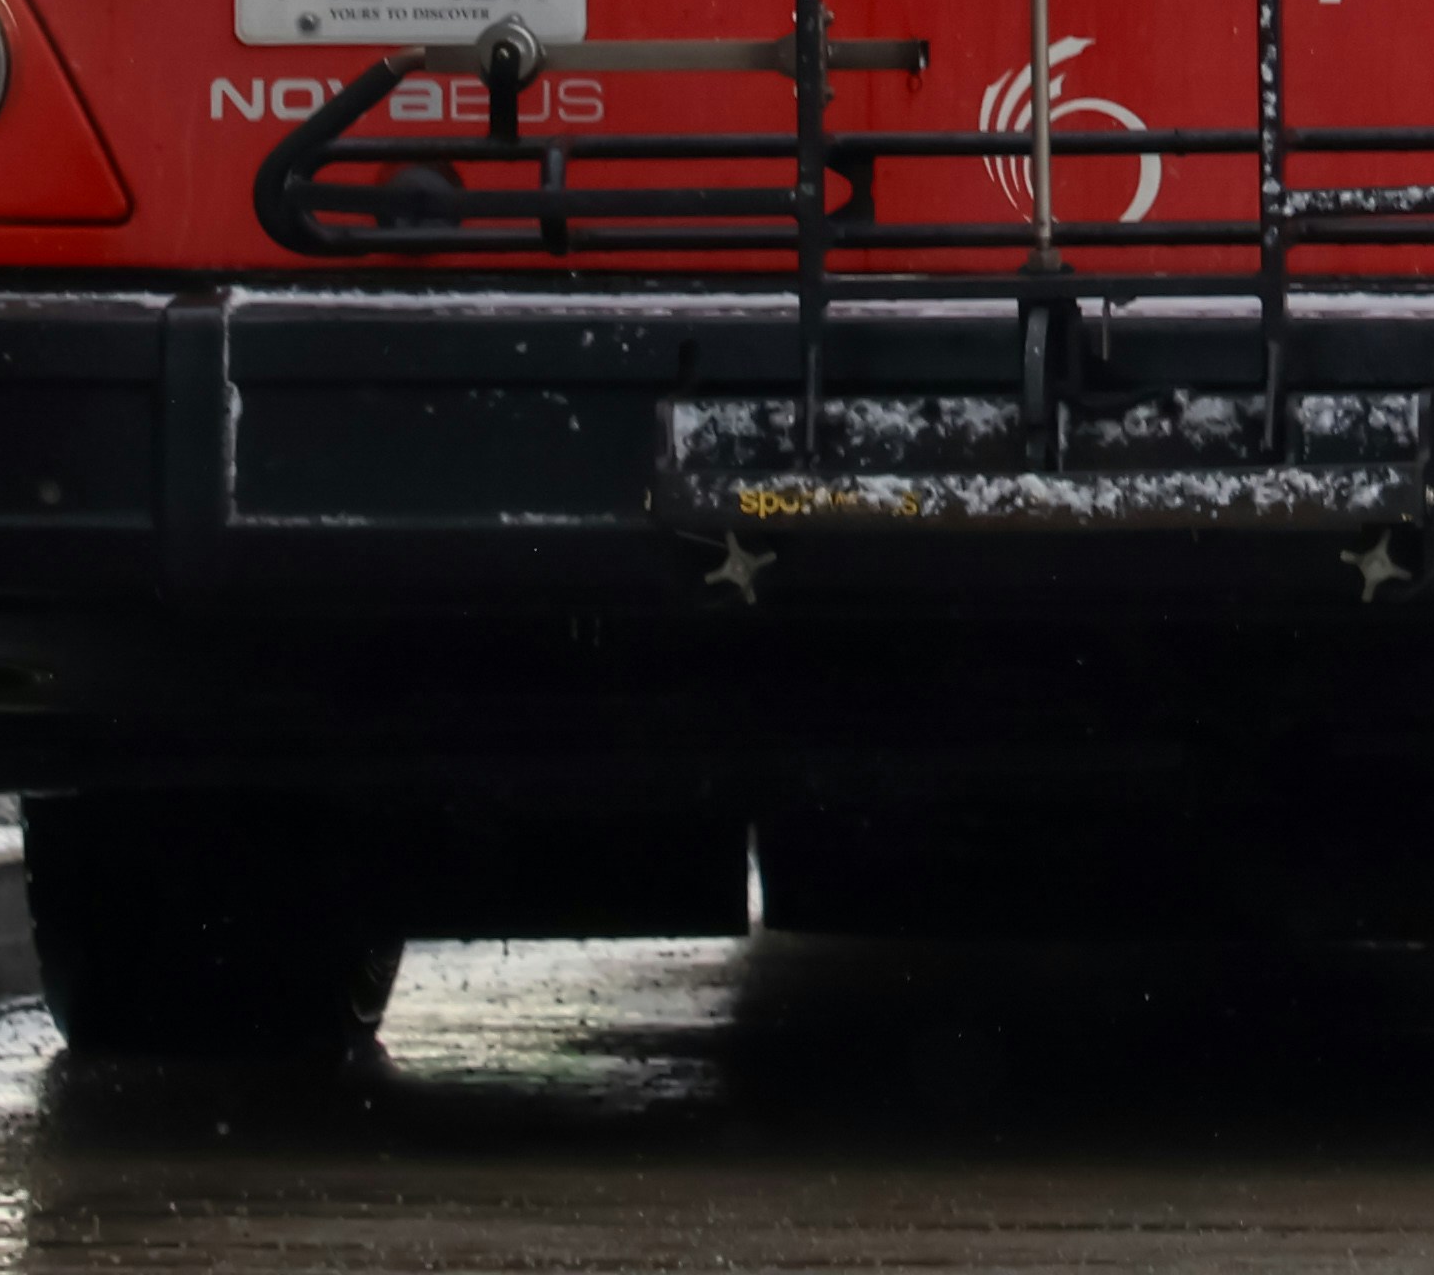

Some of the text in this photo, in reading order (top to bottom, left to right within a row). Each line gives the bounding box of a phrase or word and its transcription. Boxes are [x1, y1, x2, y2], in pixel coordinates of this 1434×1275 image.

[329, 6, 491, 22] YOURS TO DISCOVER
